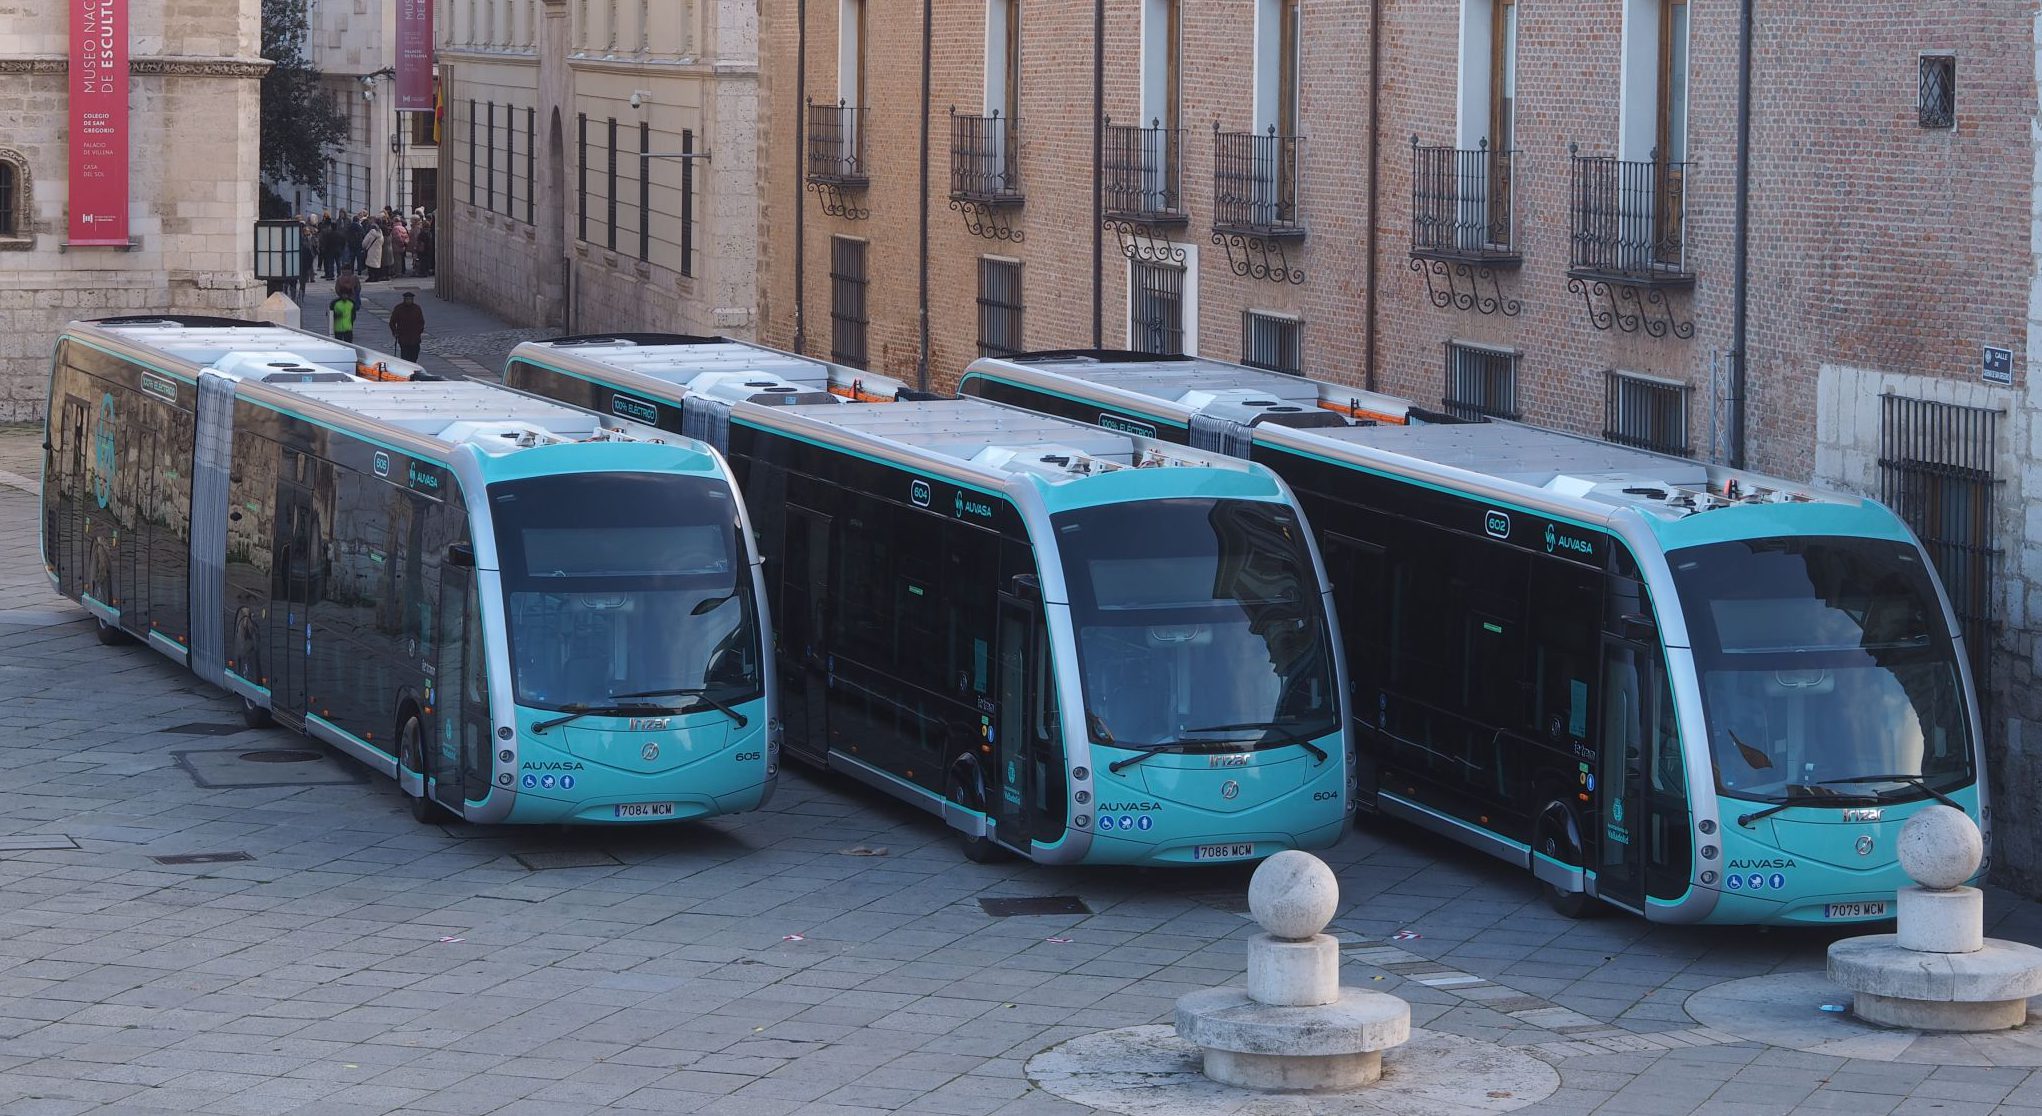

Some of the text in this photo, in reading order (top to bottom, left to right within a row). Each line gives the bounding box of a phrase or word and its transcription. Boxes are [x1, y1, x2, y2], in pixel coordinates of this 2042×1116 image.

[84, 40, 96, 92] MUSEO
[101, 75, 113, 92] DE
[1995, 352, 2008, 360] CALLE
[614, 400, 627, 411] 100%
[376, 458, 387, 470] 605
[914, 487, 928, 500] 604
[965, 501, 992, 517] AUVASA
[1489, 518, 1506, 531] 602
[1559, 536, 1593, 554] AUVASA
[736, 752, 760, 761] 605
[522, 762, 584, 770] AUVASA
[1313, 791, 1338, 800] 604
[621, 804, 672, 816] 7084 MCM
[1098, 802, 1162, 811] AUVASA
[1201, 845, 1252, 857] 7086 MCM
[1728, 859, 1796, 868] AUVASA
[1832, 903, 1884, 916] 7079 MCM
